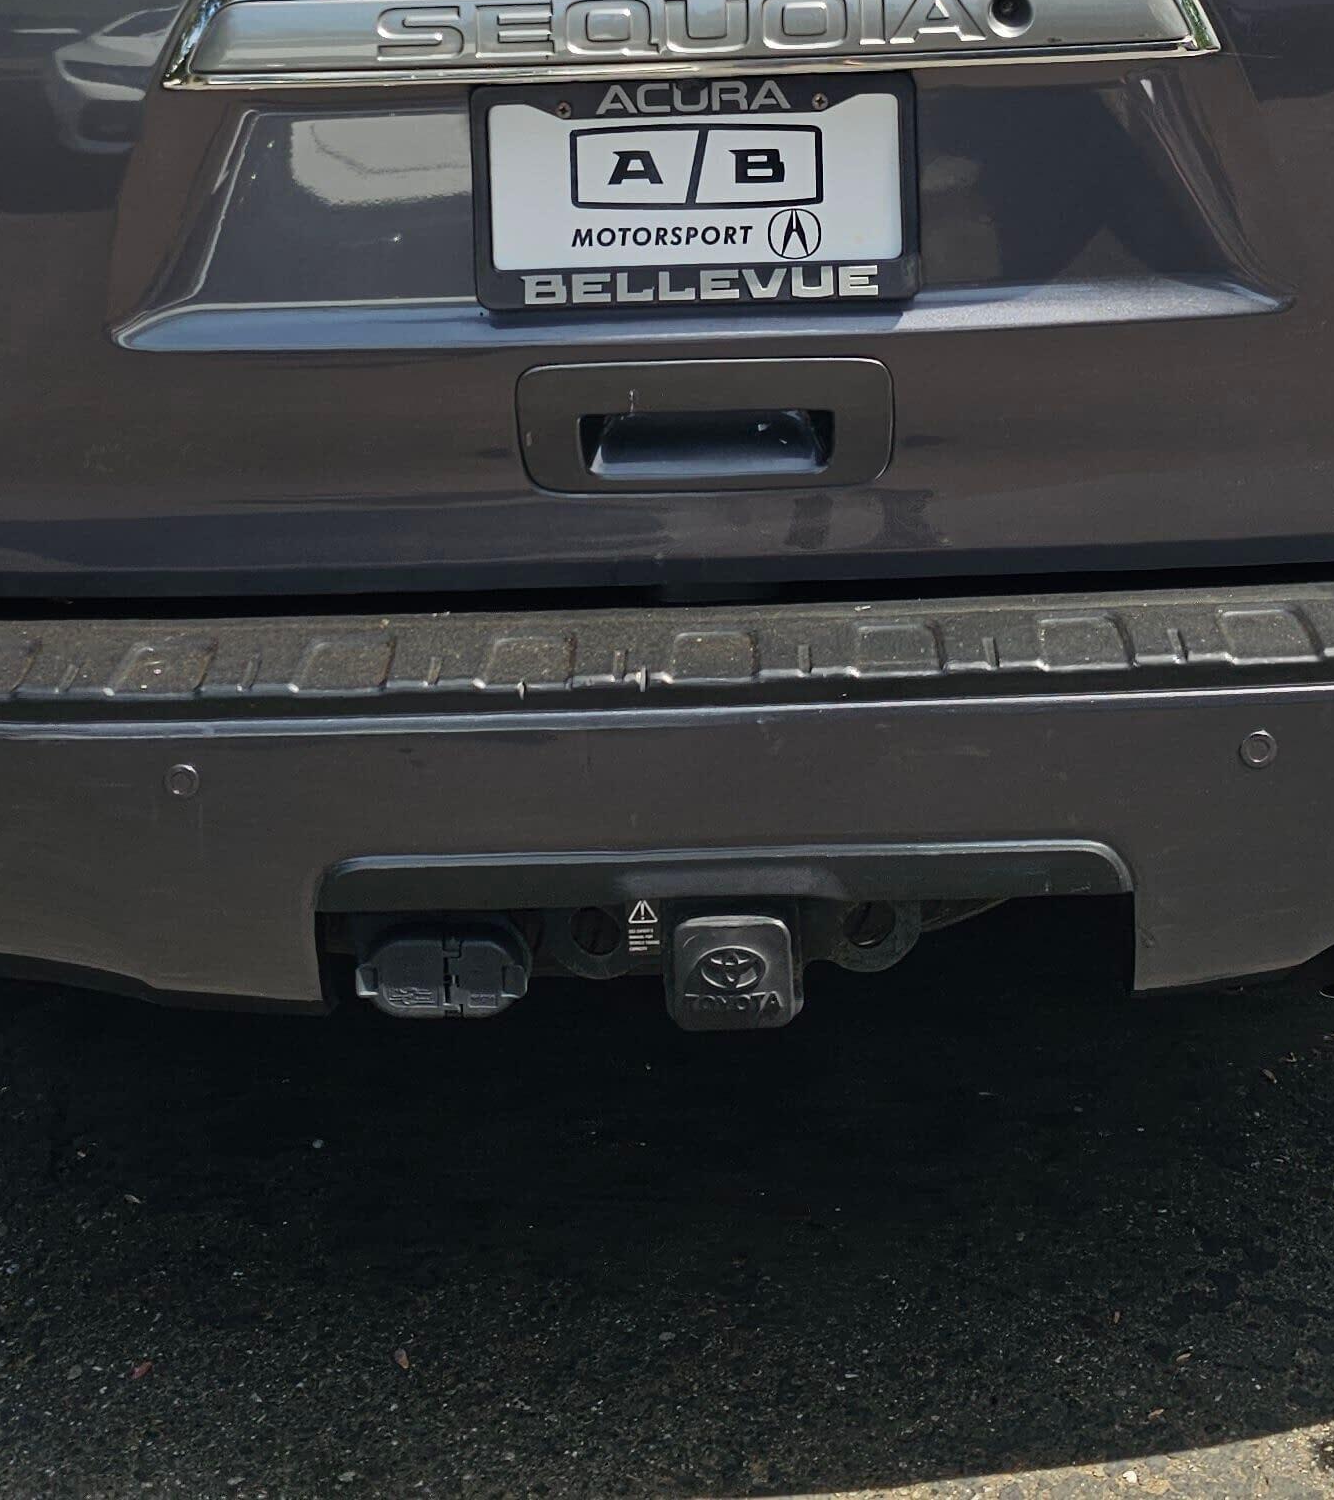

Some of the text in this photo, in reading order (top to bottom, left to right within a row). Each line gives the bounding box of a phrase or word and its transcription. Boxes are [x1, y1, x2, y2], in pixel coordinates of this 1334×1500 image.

[595, 80, 791, 115] ACURA
[571, 225, 753, 248] MOTORSPORT
[521, 264, 879, 306] BELLEVUE
